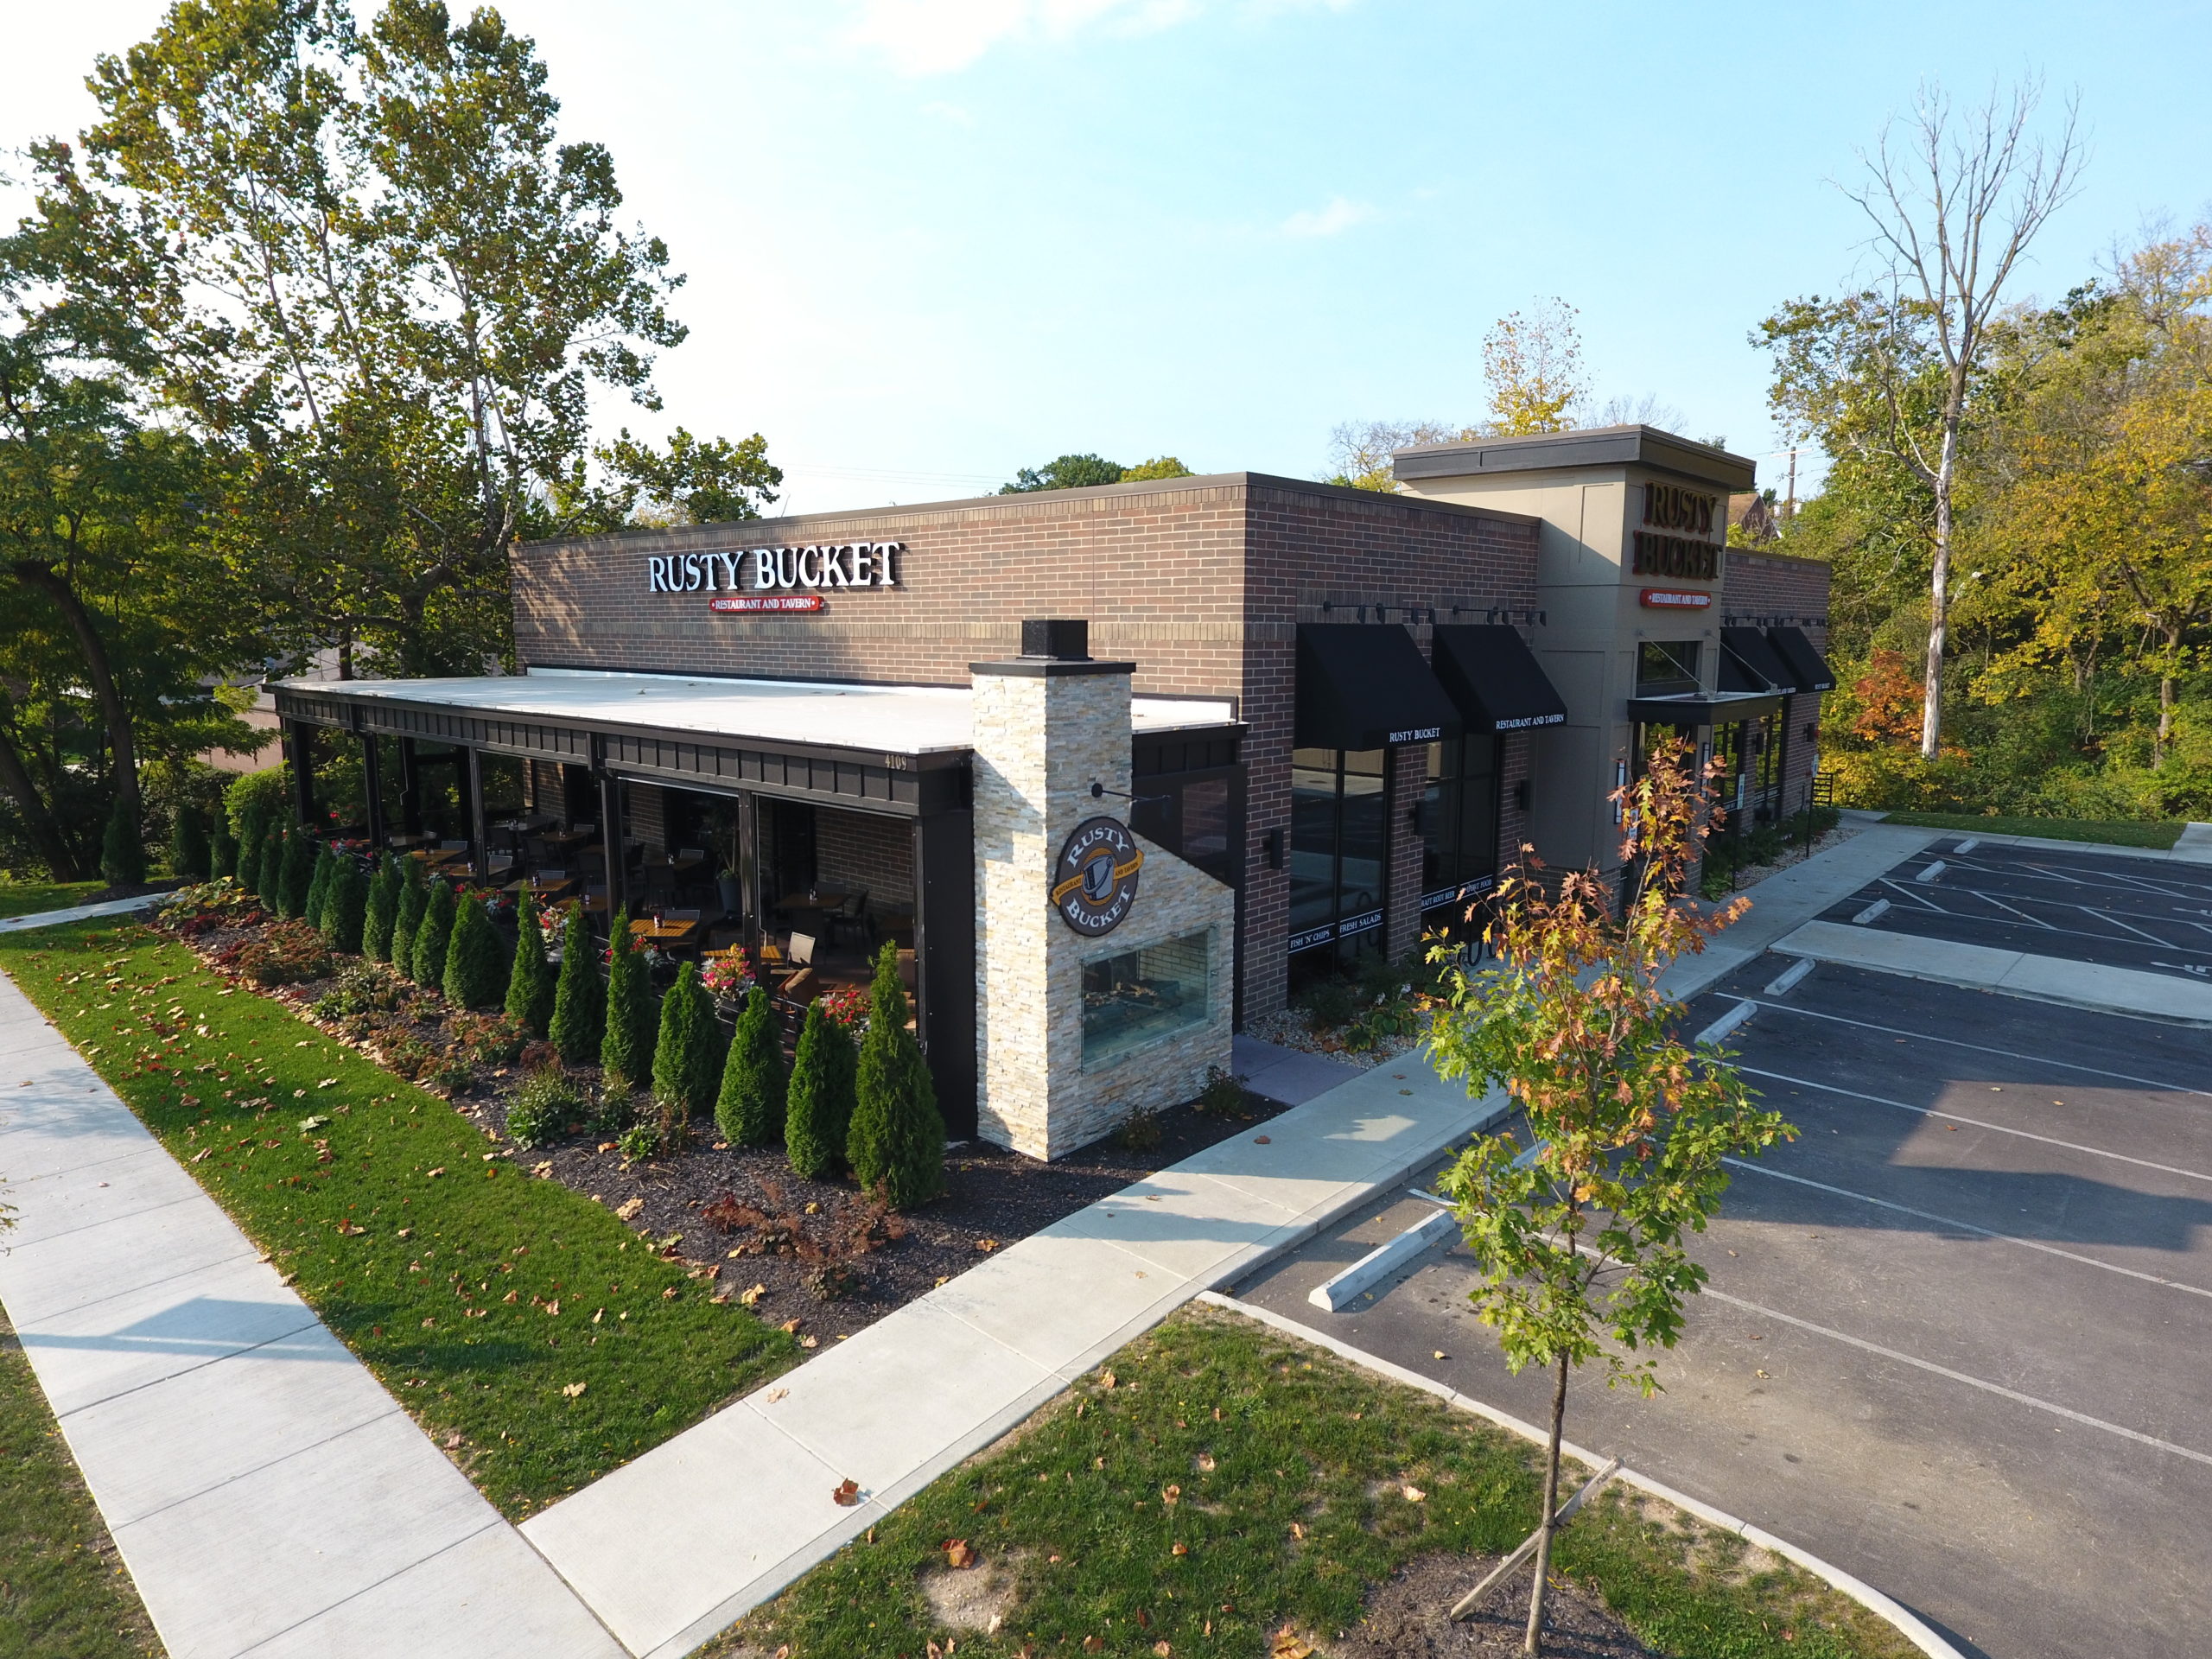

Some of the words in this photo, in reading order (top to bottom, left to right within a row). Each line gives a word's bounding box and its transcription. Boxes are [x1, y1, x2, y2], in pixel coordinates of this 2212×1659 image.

[1645, 480, 1719, 533] RUSTY
[1634, 531, 1722, 580] BUCKET
[648, 550, 744, 593] RUSTY
[753, 542, 900, 589] BUCKET
[715, 600, 761, 611] RESTAURANT
[762, 599, 779, 609] AND
[780, 598, 811, 609] TAVERN
[1496, 717, 1531, 730] RESTAURANT
[1532, 715, 1544, 726] AND
[1545, 714, 1564, 724] TAVERN
[1389, 730, 1412, 742] RUSTY
[1414, 728, 1440, 740] BUCKET
[885, 753, 907, 771] 4109
[1067, 827, 1129, 868] RUSTY
[1066, 885, 1131, 927] BUCKET
[1433, 894, 1445, 904] ROOT
[1445, 890, 1455, 899] BEER
[1339, 921, 1357, 933] FRESH
[1359, 913, 1381, 926] SALADS
[1290, 937, 1303, 948] FISH
[1313, 929, 1330, 941] CHIPS
